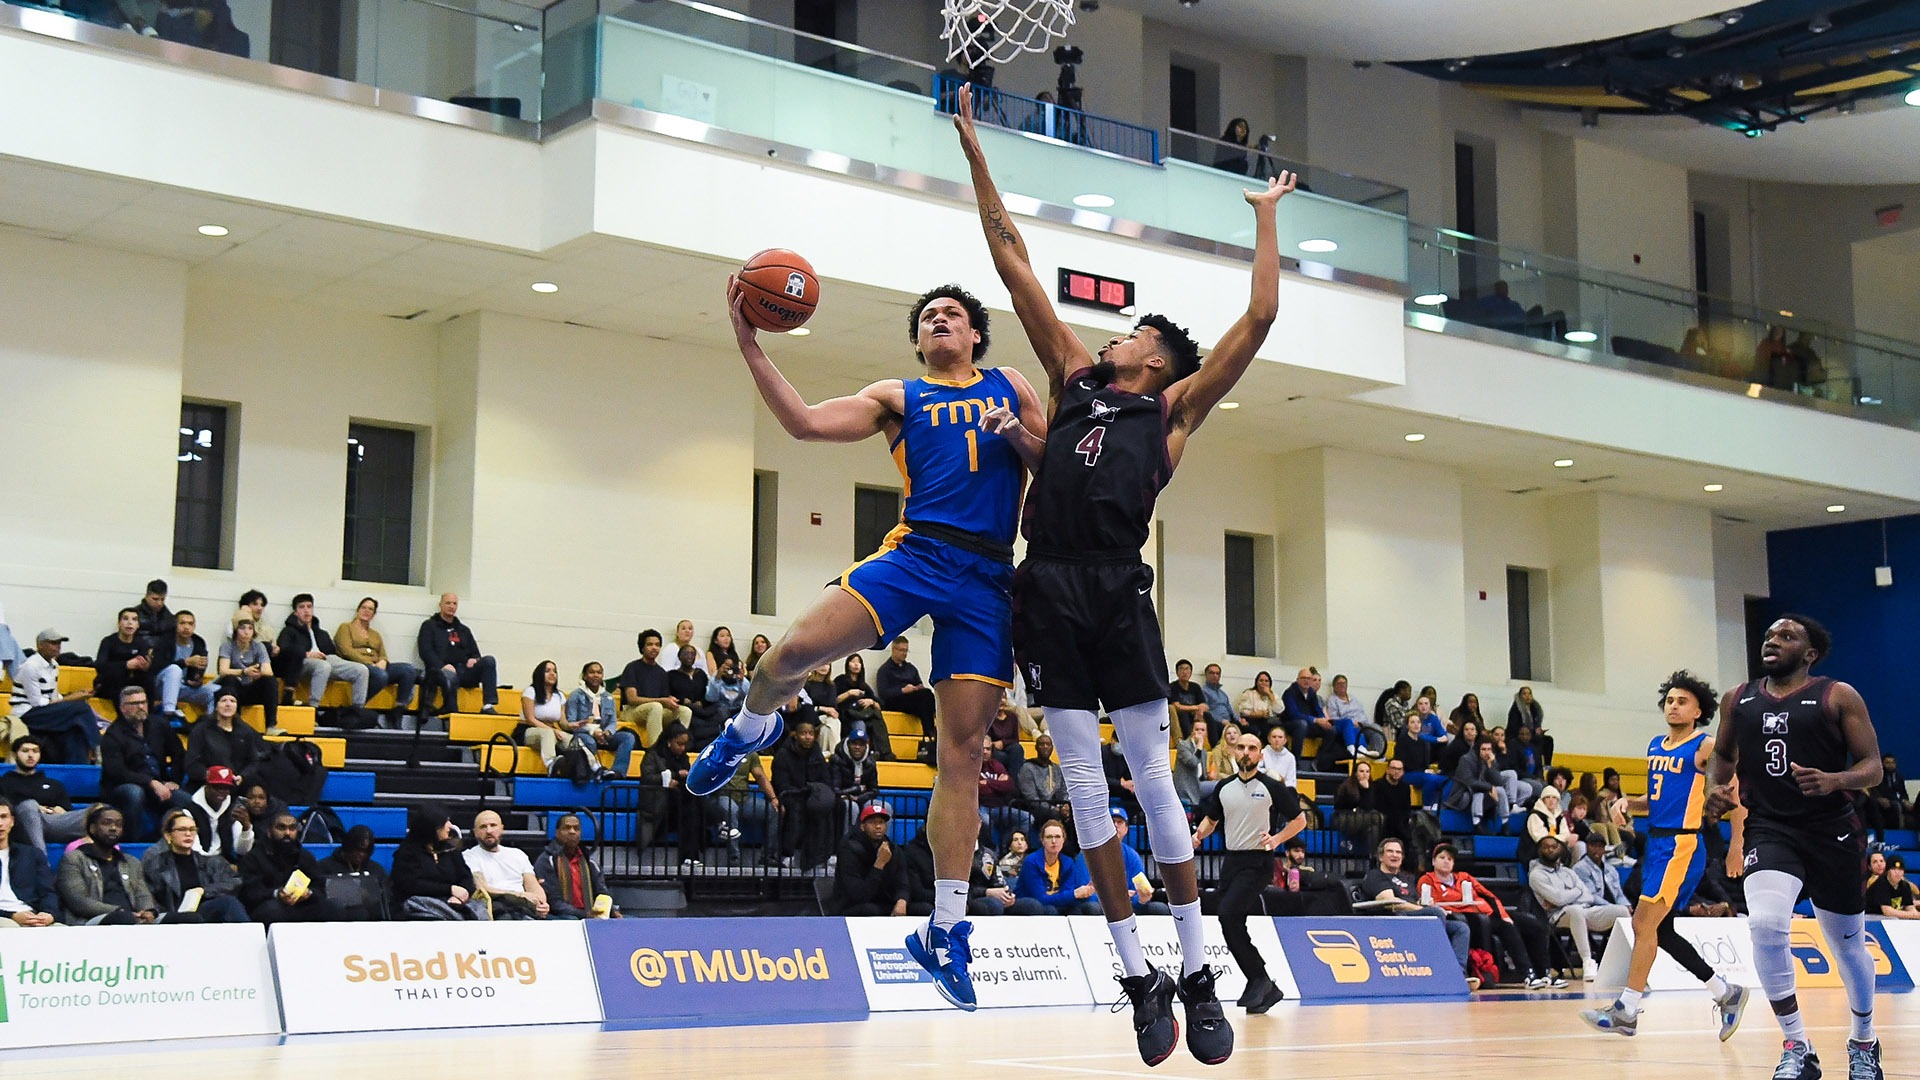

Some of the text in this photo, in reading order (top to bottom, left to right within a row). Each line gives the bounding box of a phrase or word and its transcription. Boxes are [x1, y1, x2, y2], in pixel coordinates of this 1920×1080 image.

[759, 297, 808, 321] Wilson
[964, 429, 978, 472] 1
[1075, 426, 1106, 466] 4
[1765, 739, 1787, 776] 3
[1650, 773, 1664, 800] 3
[993, 947, 1003, 958] a
[1006, 943, 1070, 960] student,
[1369, 936, 1395, 949] Best
[343, 950, 537, 985] Salad King
[629, 947, 830, 988] @TMUbold
[870, 951, 904, 961] Toronto
[1375, 949, 1417, 963] Seats in
[17, 957, 164, 988] Holiday Inn
[875, 970, 920, 981] University
[1011, 965, 1067, 981] alumni.
[1380, 964, 1433, 977] the House
[19, 986, 257, 1009] Toronto Downtown Centre
[394, 985, 496, 1001] THAI FOOD
